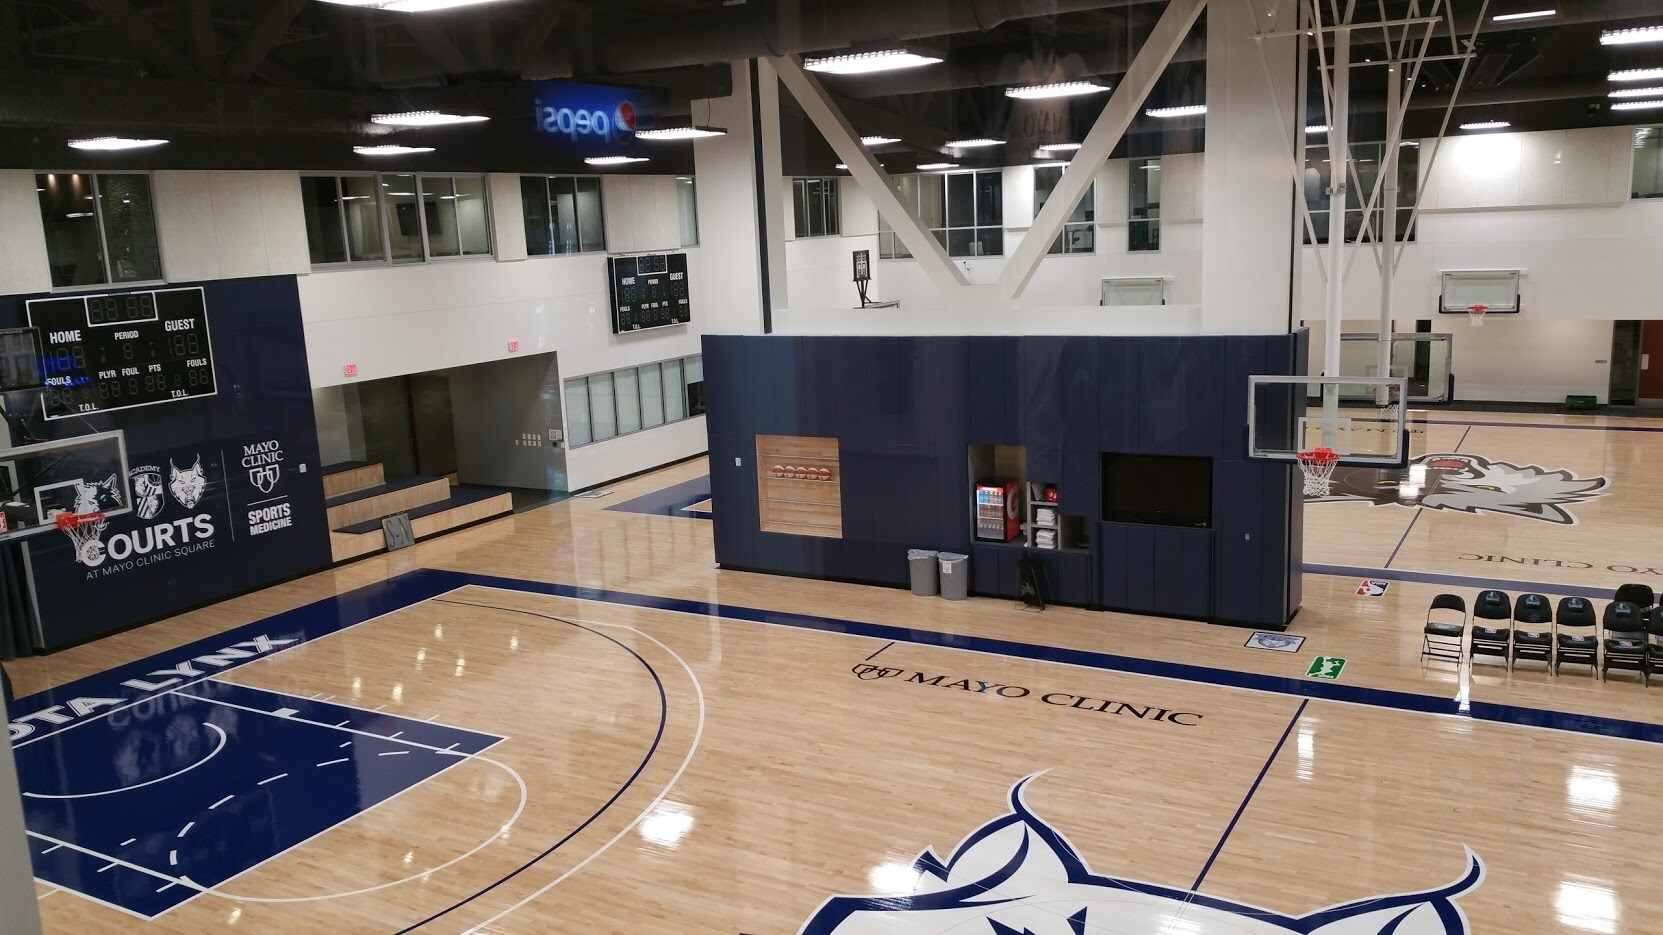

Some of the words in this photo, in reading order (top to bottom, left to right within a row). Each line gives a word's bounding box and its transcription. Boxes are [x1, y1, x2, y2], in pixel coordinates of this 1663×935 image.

[621, 276, 636, 286] HOME
[669, 272, 684, 281] GUEST
[164, 318, 195, 332] GUEST
[49, 330, 82, 344] HOME
[114, 330, 139, 341] PERIOD
[186, 358, 207, 368] FOULS
[98, 369, 116, 380] PLYR
[121, 366, 140, 377] FOUL
[148, 363, 162, 373] PTS
[46, 376, 71, 386] FOULS
[171, 389, 189, 398] T.O.L.
[78, 402, 99, 412] T.O.L.
[242, 440, 279, 456] MAYO
[241, 450, 284, 468] CLINIC
[247, 502, 292, 525] SPORTS
[249, 516, 293, 536] MEDICINE
[80, 513, 215, 567] COURTS
[86, 568, 99, 581] AT
[102, 560, 134, 577] MAYO
[136, 550, 172, 568] CLINIC
[173, 539, 216, 557] SQUARE
[1458, 553, 1594, 569] CLINIC
[120, 634, 299, 691] LYNX
[903, 672, 1031, 699] MAYO
[1041, 692, 1204, 727] CLINIC
